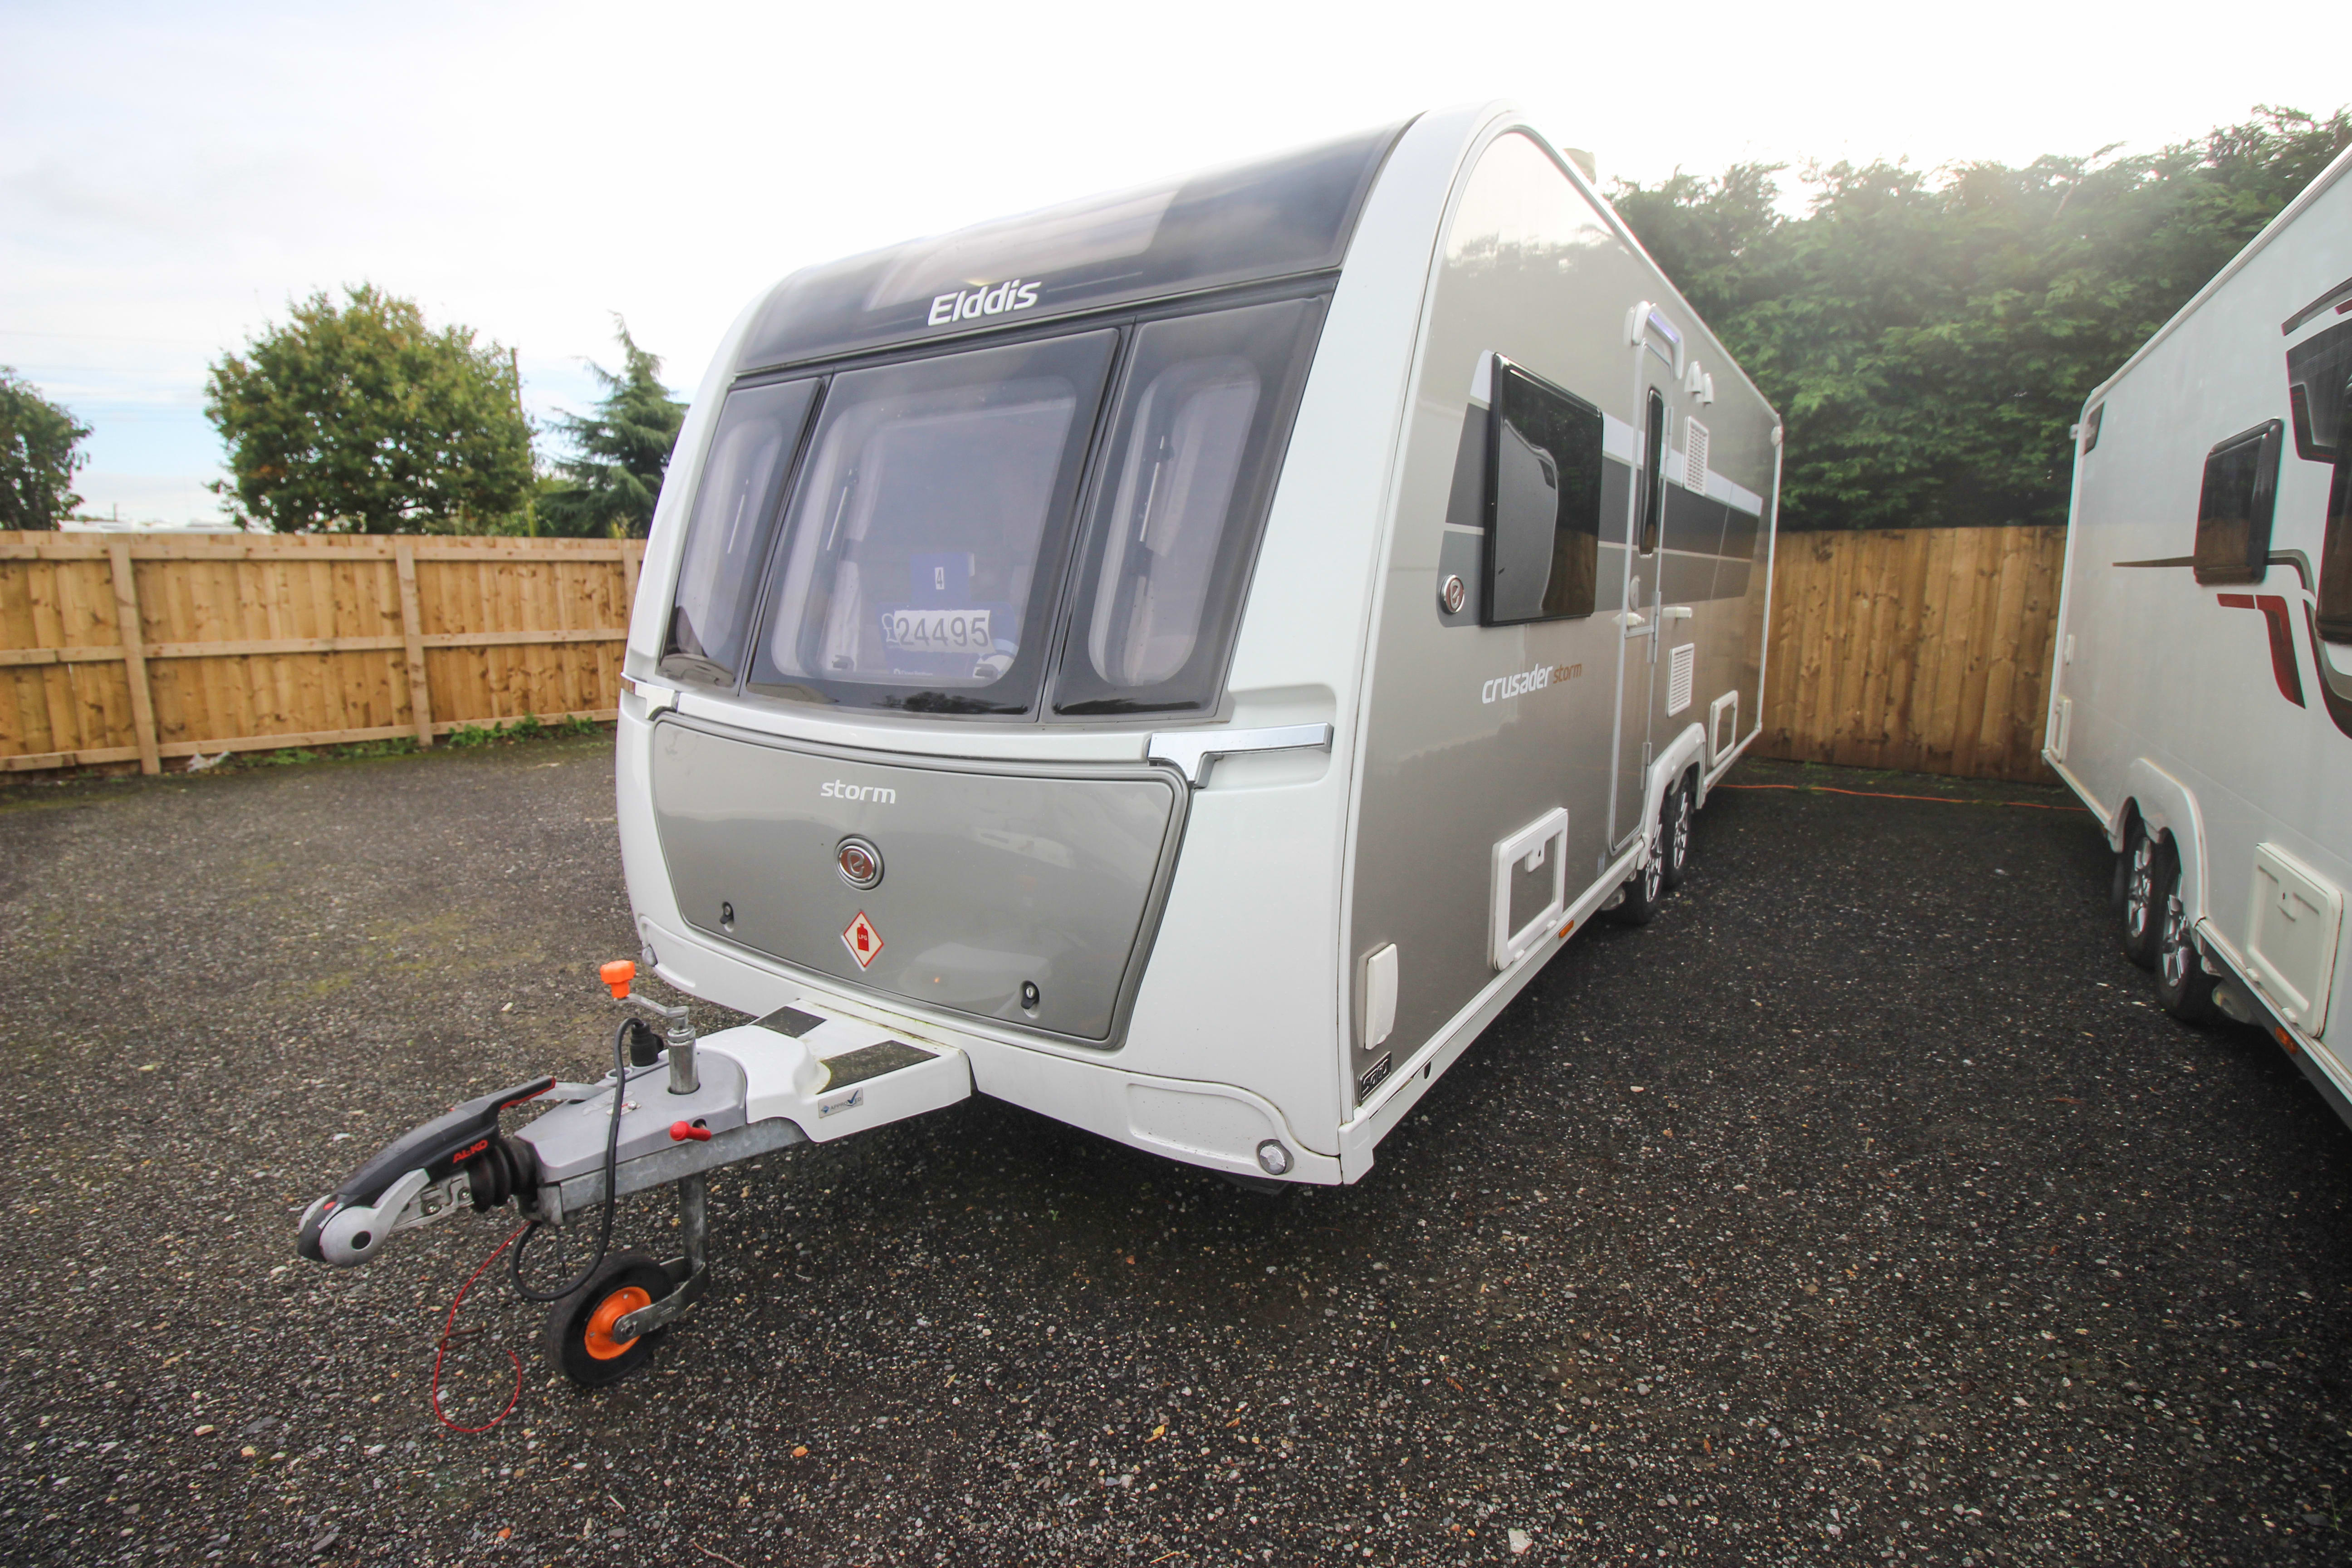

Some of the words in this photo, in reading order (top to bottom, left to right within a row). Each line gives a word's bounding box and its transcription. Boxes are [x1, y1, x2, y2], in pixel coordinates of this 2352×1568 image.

[927, 279, 1042, 326] Elddis
[936, 568, 943, 588] 4
[882, 612, 989, 647] £24495
[1482, 663, 1553, 704] crusader
[1553, 663, 1582, 684] storm
[820, 779, 896, 804] storm
